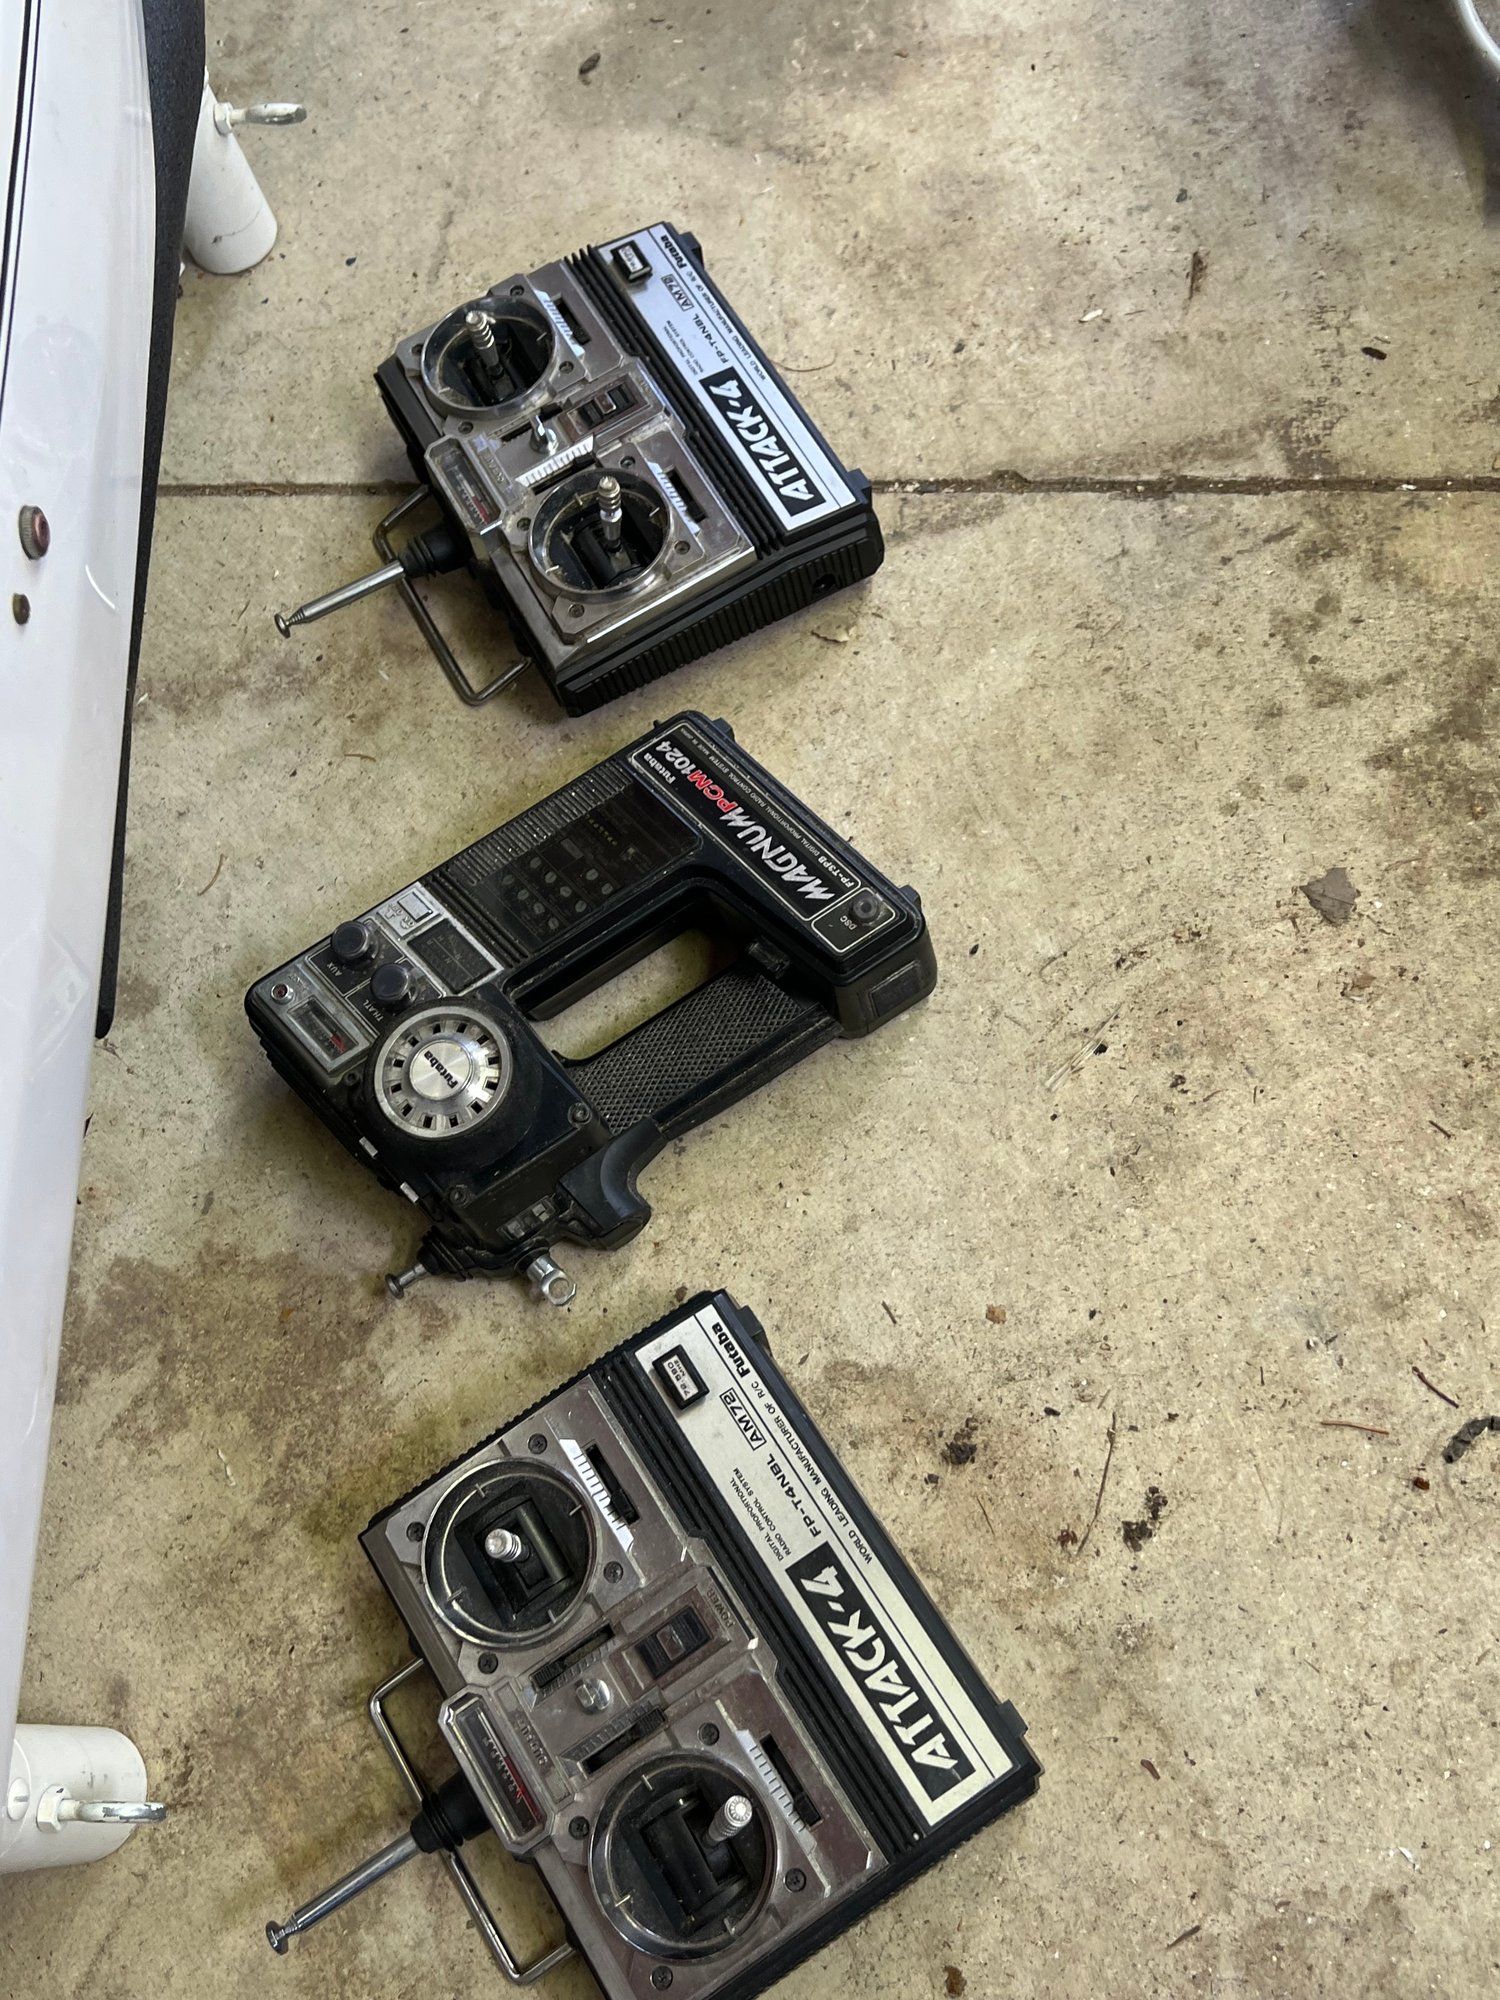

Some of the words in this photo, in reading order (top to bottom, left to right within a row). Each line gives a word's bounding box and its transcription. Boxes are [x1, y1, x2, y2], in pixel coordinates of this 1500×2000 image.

[659, 234, 687, 268] Futaba
[692, 313, 729, 362] FP-T4NBL
[731, 334, 751, 359] LEADING
[748, 359, 766, 381] WORLD
[709, 378, 814, 500] ATTACK-4
[641, 752, 676, 784] Futaba
[708, 754, 729, 773] SYSTEM
[727, 771, 752, 794] CONTROL
[749, 791, 767, 807] RADIO
[764, 805, 802, 839] PROPORTIONAL
[800, 837, 820, 856] DIGITAL
[817, 855, 854, 886] FP-T3PB
[839, 913, 857, 931] DSC
[325, 961, 342, 975] AUX
[422, 1050, 458, 1088] Futaba
[709, 1321, 751, 1377] Futaba
[749, 1380, 765, 1398] R/C
[722, 1391, 763, 1444] AM72
[763, 1401, 776, 1414] OF
[773, 1416, 821, 1484] MANUFACTURER
[732, 1467, 754, 1496] SYSTEM
[762, 1452, 821, 1537] FP-T4NBL
[728, 1476, 765, 1530] PROPORTIONAL
[750, 1496, 776, 1531] CONTROL
[819, 1487, 850, 1526] LEADING
[762, 1532, 784, 1560] DIGITAL
[773, 1532, 791, 1555] RADIO
[846, 1528, 873, 1562] WORLD
[705, 1587, 734, 1628] POWER
[800, 1564, 958, 1768] ATTACK-4
